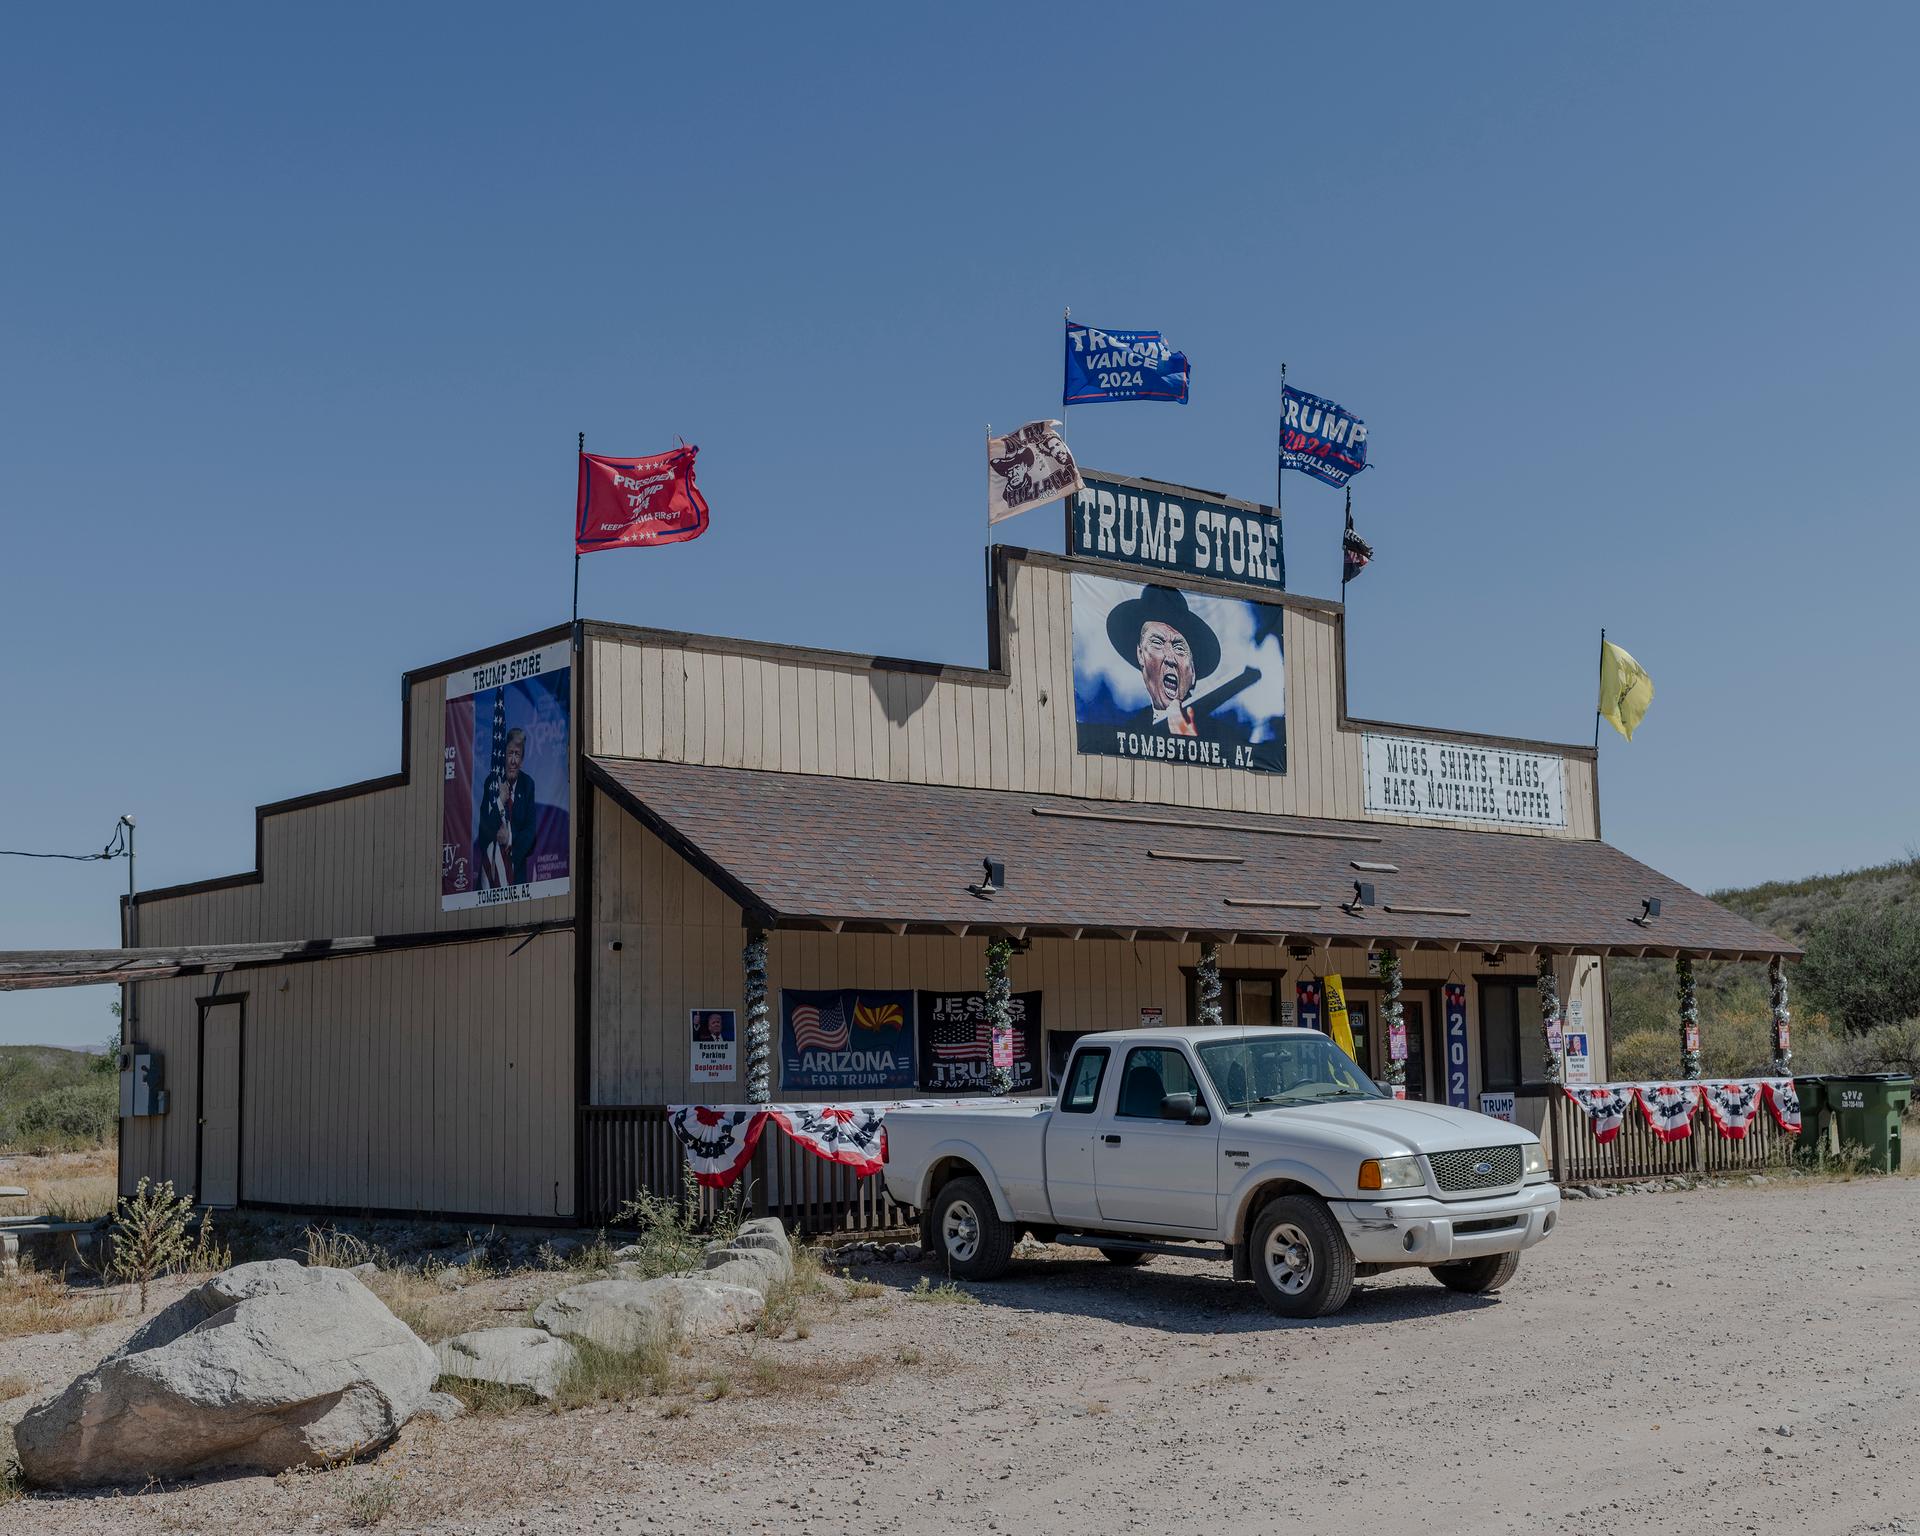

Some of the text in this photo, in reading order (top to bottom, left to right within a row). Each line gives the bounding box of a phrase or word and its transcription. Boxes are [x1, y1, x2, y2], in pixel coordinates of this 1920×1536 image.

[1086, 351, 1158, 370] VANCE
[1098, 371, 1144, 388] 2024
[1297, 452, 1349, 482] BULLSHIT
[627, 484, 664, 507] TMP
[655, 511, 681, 522] FIRST!
[1078, 487, 1184, 564] TRUMP
[1195, 509, 1281, 581] STORE
[473, 654, 541, 690] TRUMP STORE
[1116, 731, 1254, 767] TOMBSTONE, AZ
[1387, 743, 1545, 793] MUGS, SHIRTS, FLAGS,
[1384, 777, 1550, 819] HATS, NOVELTIES, COFFEE
[477, 884, 531, 905] TOMBSTONE, AZ
[934, 996, 1025, 1014] JESS
[932, 1012, 1026, 1021] IS MY SOR
[801, 1051, 896, 1072] ARIZONA
[932, 1061, 1032, 1080] TRUP
[811, 1073, 887, 1085] FOR TRUMP
[945, 1080, 965, 1088] MY
[968, 1078, 1032, 1087] PREENT
[1483, 1099, 1513, 1112] TRUMP
